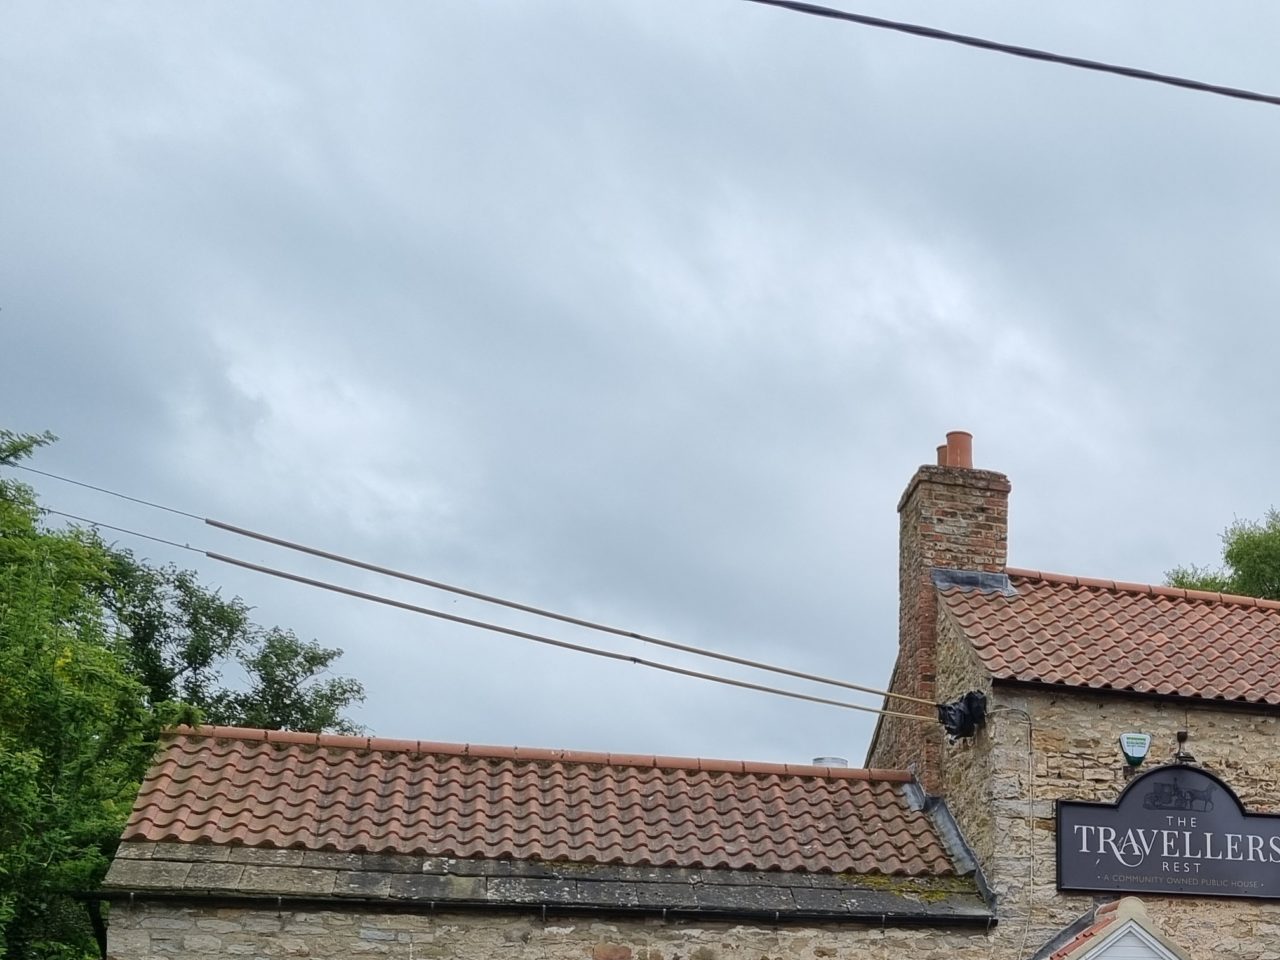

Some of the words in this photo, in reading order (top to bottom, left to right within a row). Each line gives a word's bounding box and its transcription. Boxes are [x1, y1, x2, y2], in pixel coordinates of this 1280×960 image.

[1166, 815, 1197, 828] THE
[1162, 861, 1201, 873] REST
[1112, 874, 1164, 884] COMMUNITY
[1166, 877, 1199, 886] OWNED
[1201, 879, 1228, 887] PUBLIC
